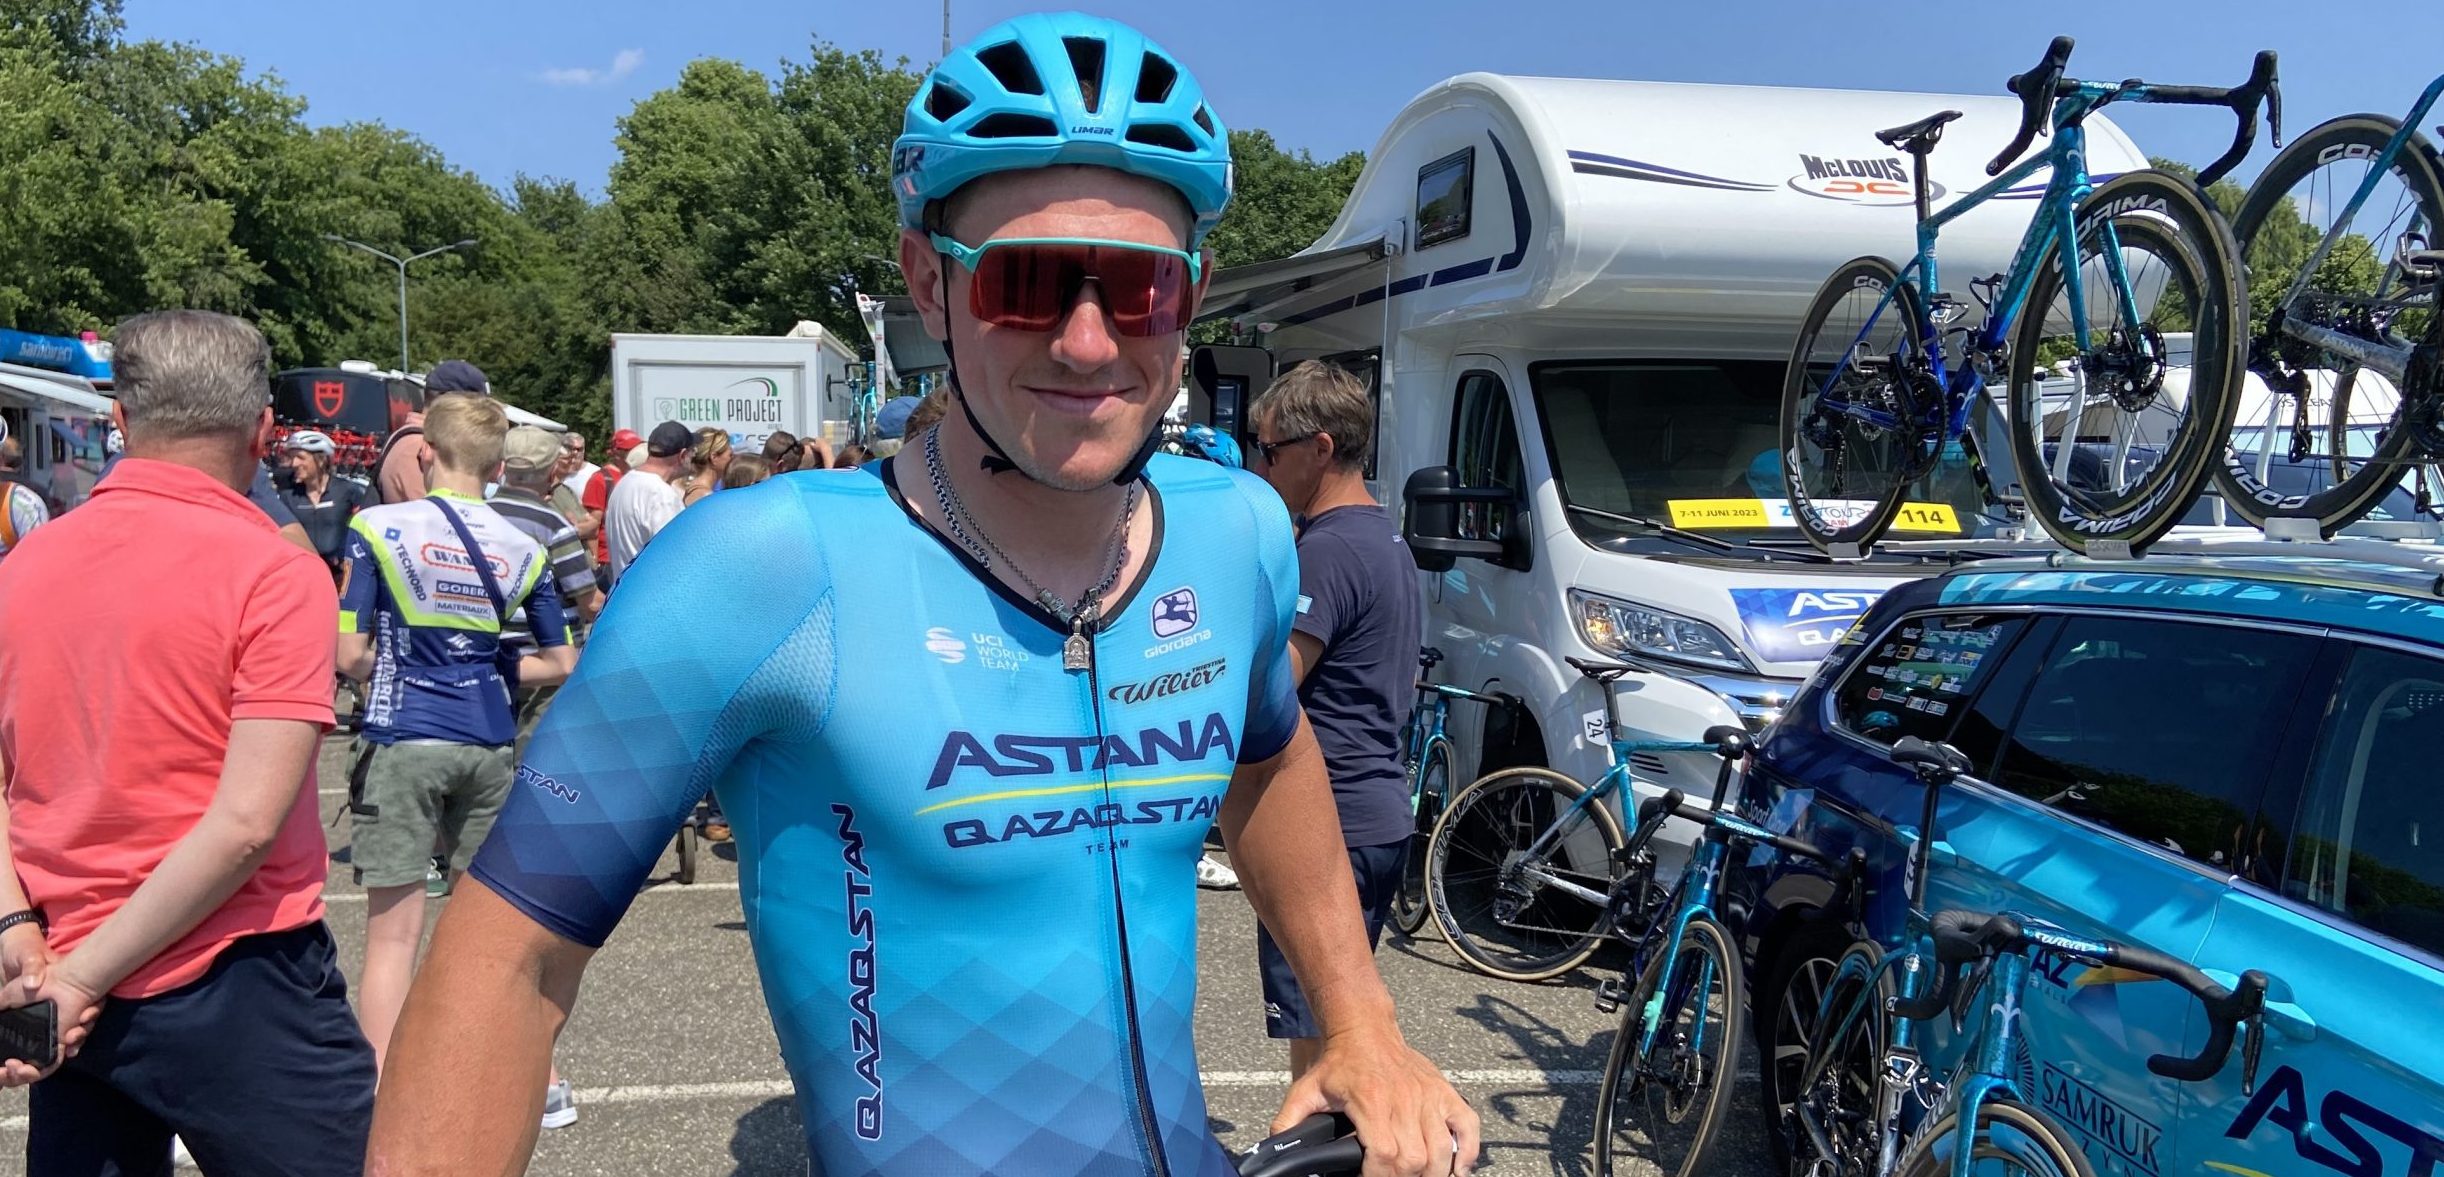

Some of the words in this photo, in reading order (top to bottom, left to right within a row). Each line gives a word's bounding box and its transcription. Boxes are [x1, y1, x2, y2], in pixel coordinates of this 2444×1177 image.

[1799, 153, 1909, 183] McLOUIS
[680, 398, 720, 421] GREEN
[727, 399, 782, 422] PROJECT
[1706, 509, 1730, 517] JUNI
[1732, 509, 1758, 517] 2023
[1902, 509, 1945, 525] 114
[395, 543, 427, 602] TECHNORD
[437, 602, 489, 615] MATERIAUX
[971, 632, 1003, 648] UCI
[975, 645, 1029, 662] WORLD
[980, 656, 1020, 672] TEAM
[1586, 718, 1605, 738] 24
[926, 712, 1235, 790] ASTANA
[1085, 838, 1130, 856] TEAM
[829, 802, 883, 1142] QAZAQSTAN
[2042, 1067, 2161, 1174] SAMRUK
